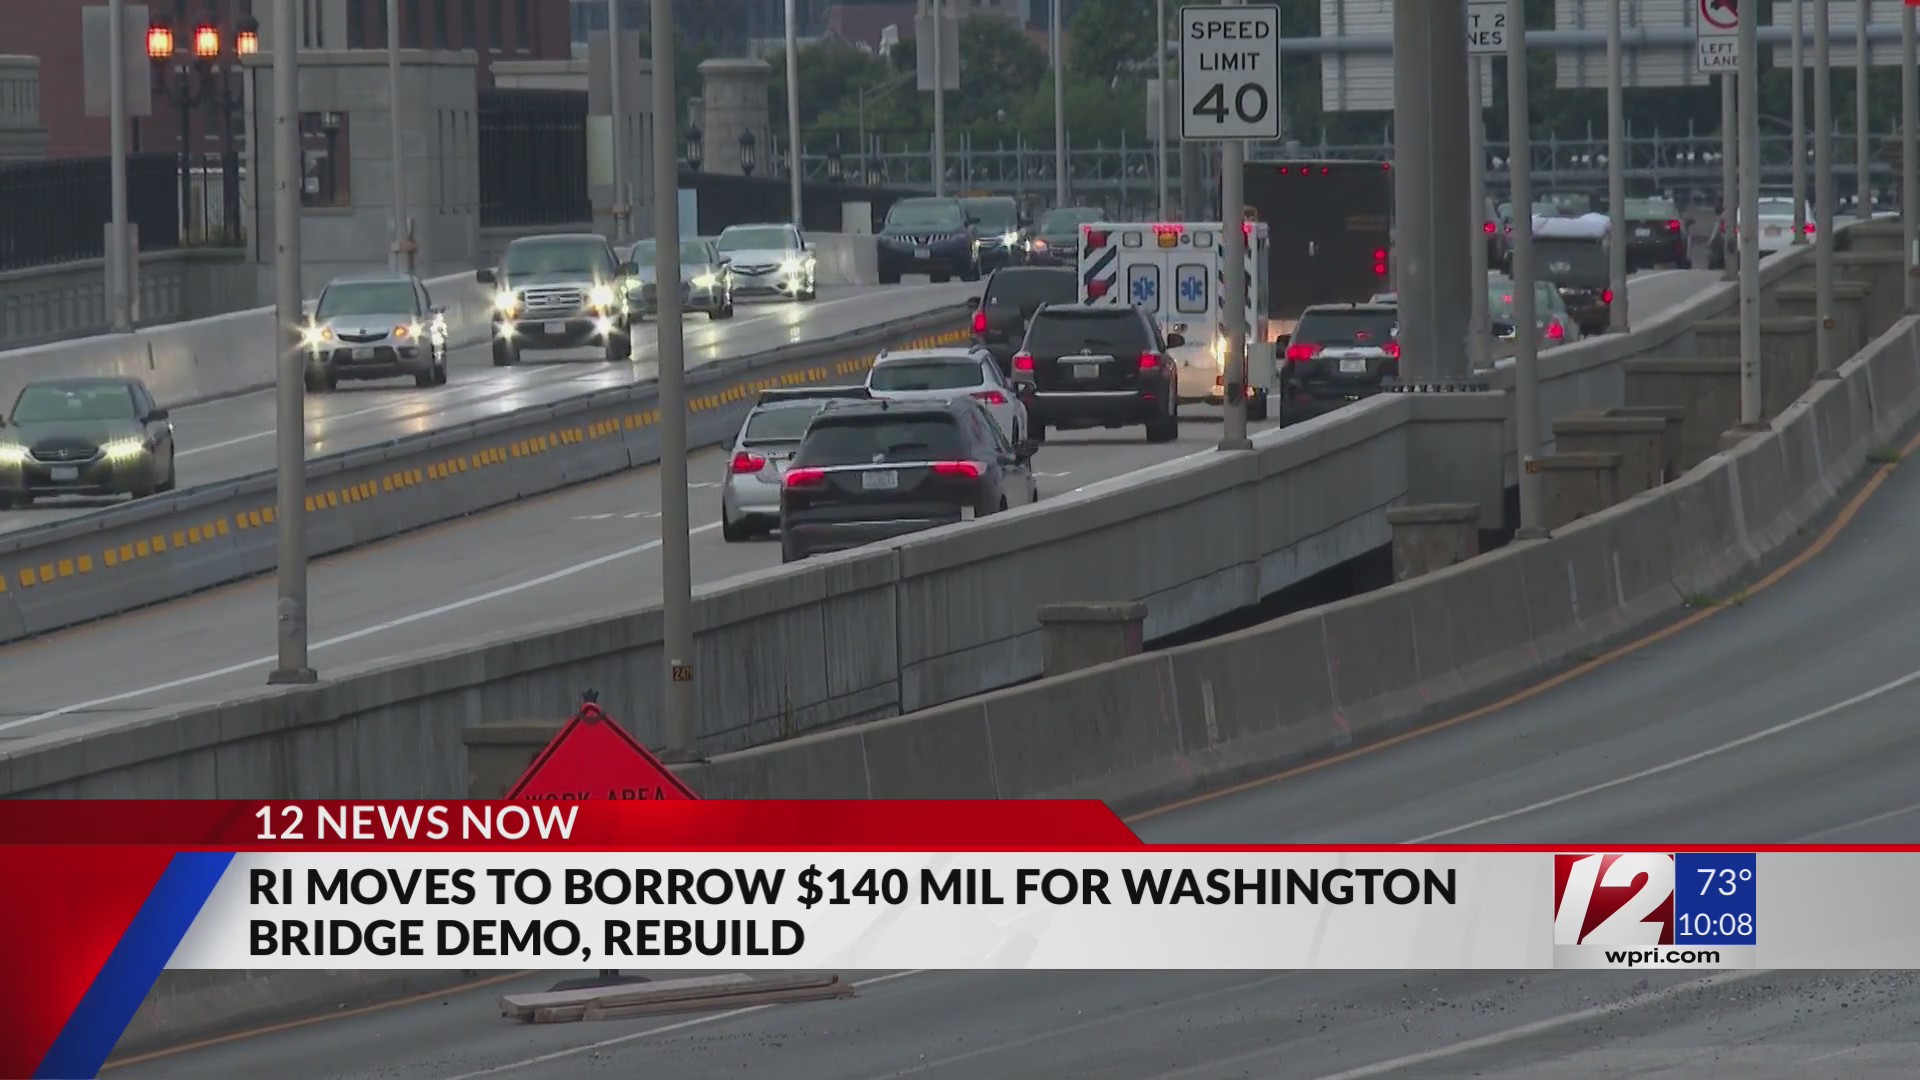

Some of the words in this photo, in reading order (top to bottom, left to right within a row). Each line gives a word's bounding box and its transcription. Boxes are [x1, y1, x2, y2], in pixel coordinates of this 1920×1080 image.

[1495, 13, 1505, 28] 2
[1191, 20, 1270, 40] SPEED
[1701, 43, 1734, 54] LEFT
[1200, 52, 1261, 71] LIMIT
[1703, 55, 1738, 66] LANE
[1192, 82, 1268, 124] 40
